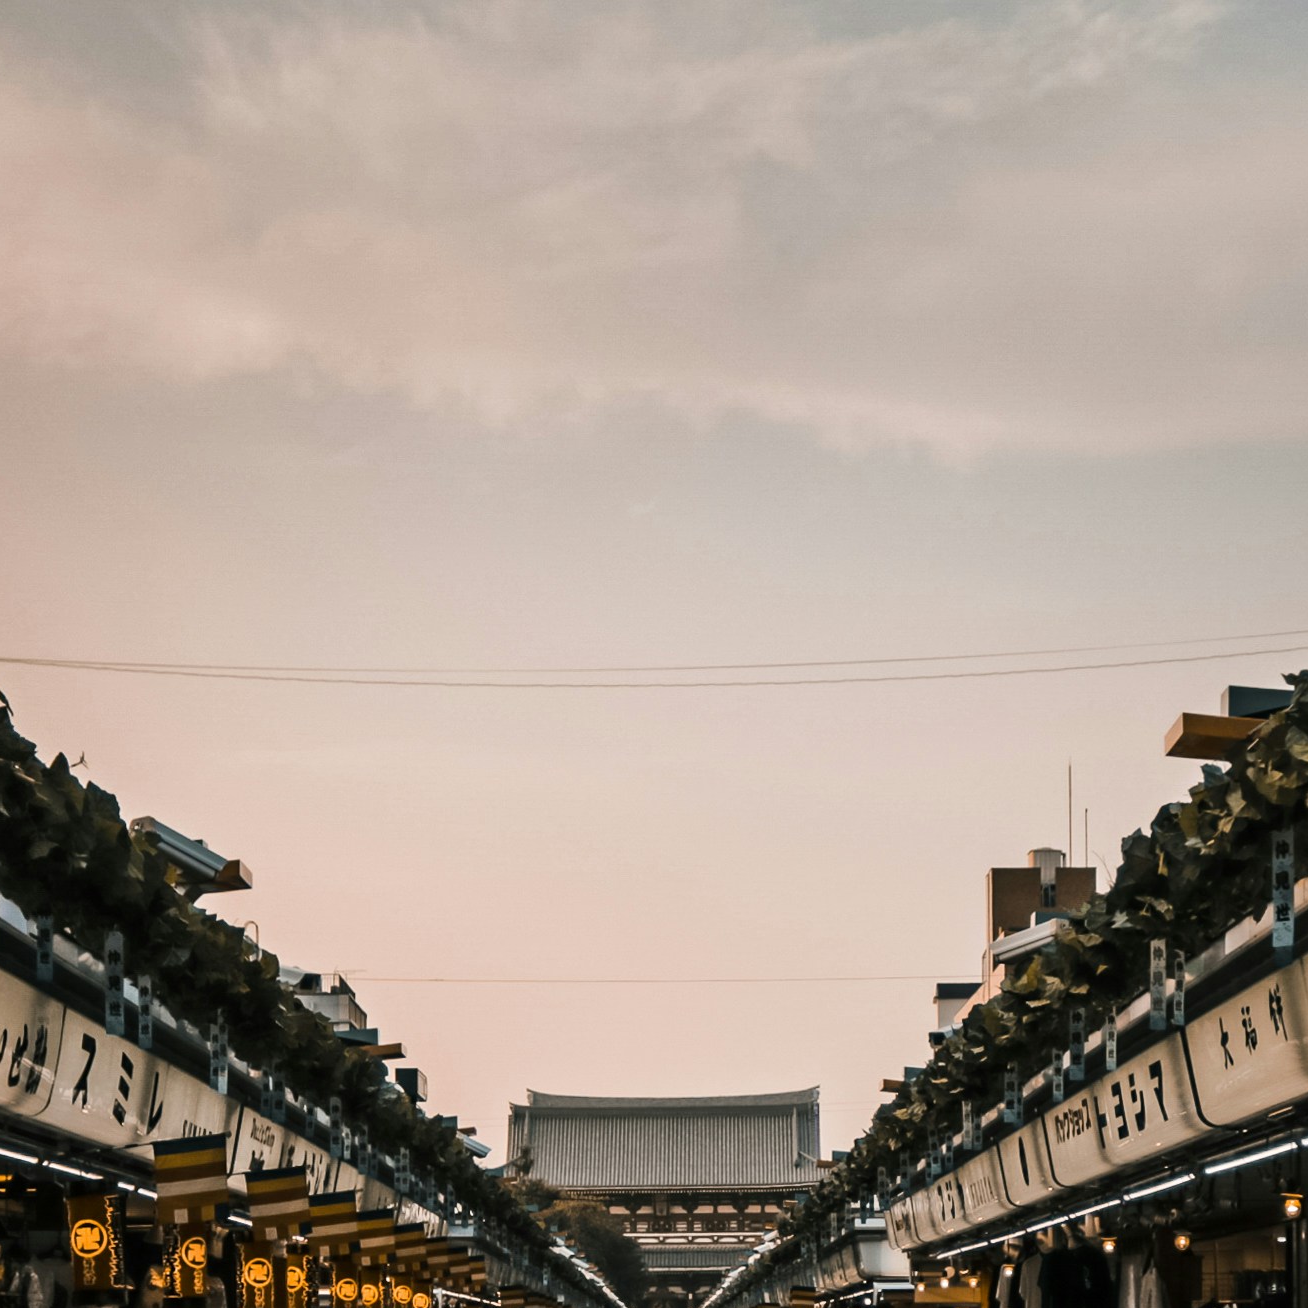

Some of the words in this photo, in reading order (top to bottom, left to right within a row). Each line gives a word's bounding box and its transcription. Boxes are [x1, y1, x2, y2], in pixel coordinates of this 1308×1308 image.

[1274, 840, 1291, 924] 仲見世
[71, 1032, 164, 1136] スミレ
[1094, 1059, 1169, 1149] トヨシマ
